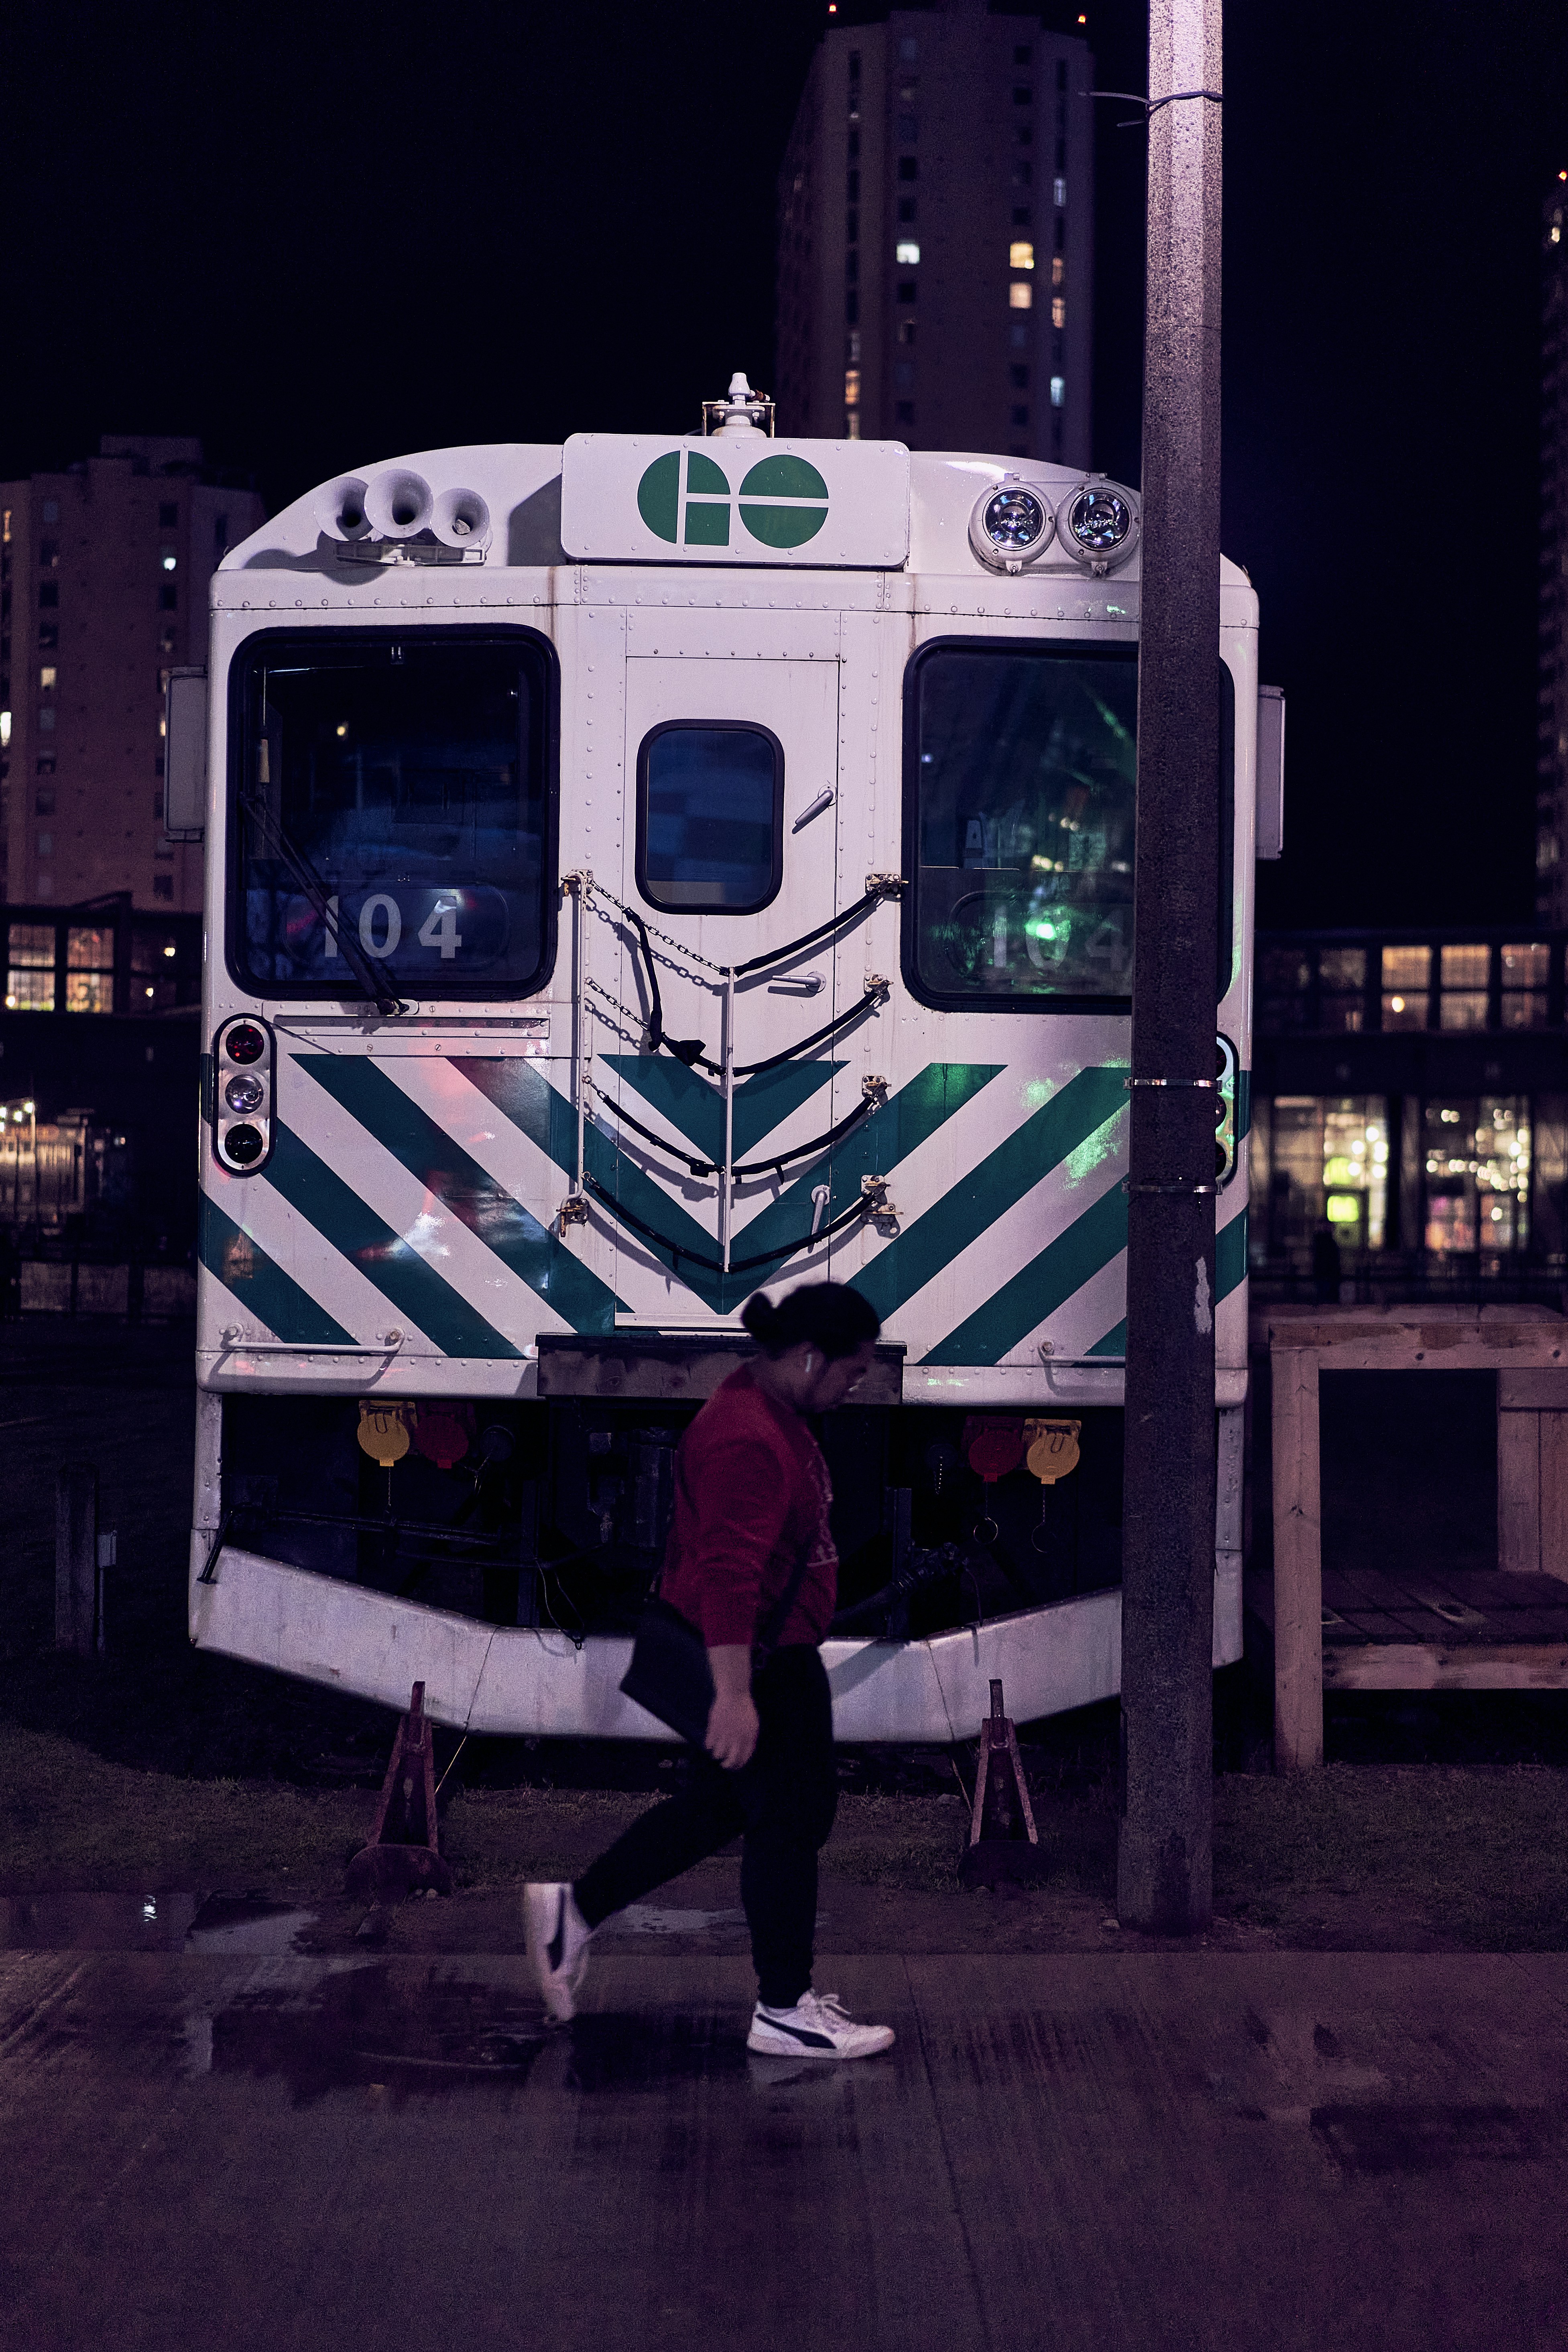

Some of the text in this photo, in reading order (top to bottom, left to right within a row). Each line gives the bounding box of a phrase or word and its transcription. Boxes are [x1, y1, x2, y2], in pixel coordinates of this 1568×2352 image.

[637, 450, 829, 549] GO
[324, 894, 462, 959] 104
[992, 903, 1131, 973] 104
